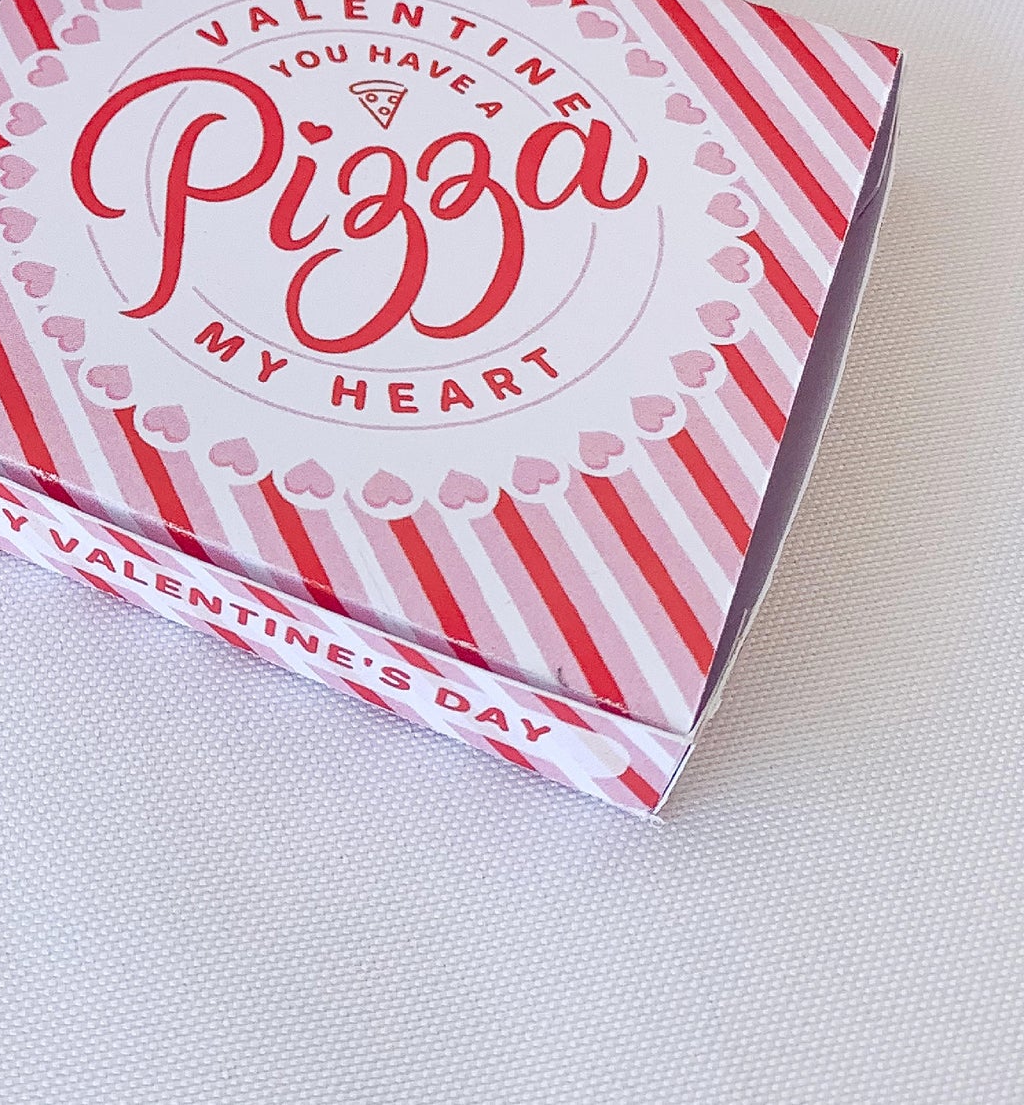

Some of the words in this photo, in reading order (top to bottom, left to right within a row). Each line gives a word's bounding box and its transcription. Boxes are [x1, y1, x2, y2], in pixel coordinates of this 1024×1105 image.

[269, 43, 349, 80] YOU
[368, 44, 476, 96] HAVE
[476, 100, 505, 121] A
[70, 66, 649, 355] Pizza
[193, 320, 289, 384] MY
[329, 346, 560, 414] HEART
[47, 527, 411, 691] VALENTINE'S
[433, 688, 553, 747] DAY
